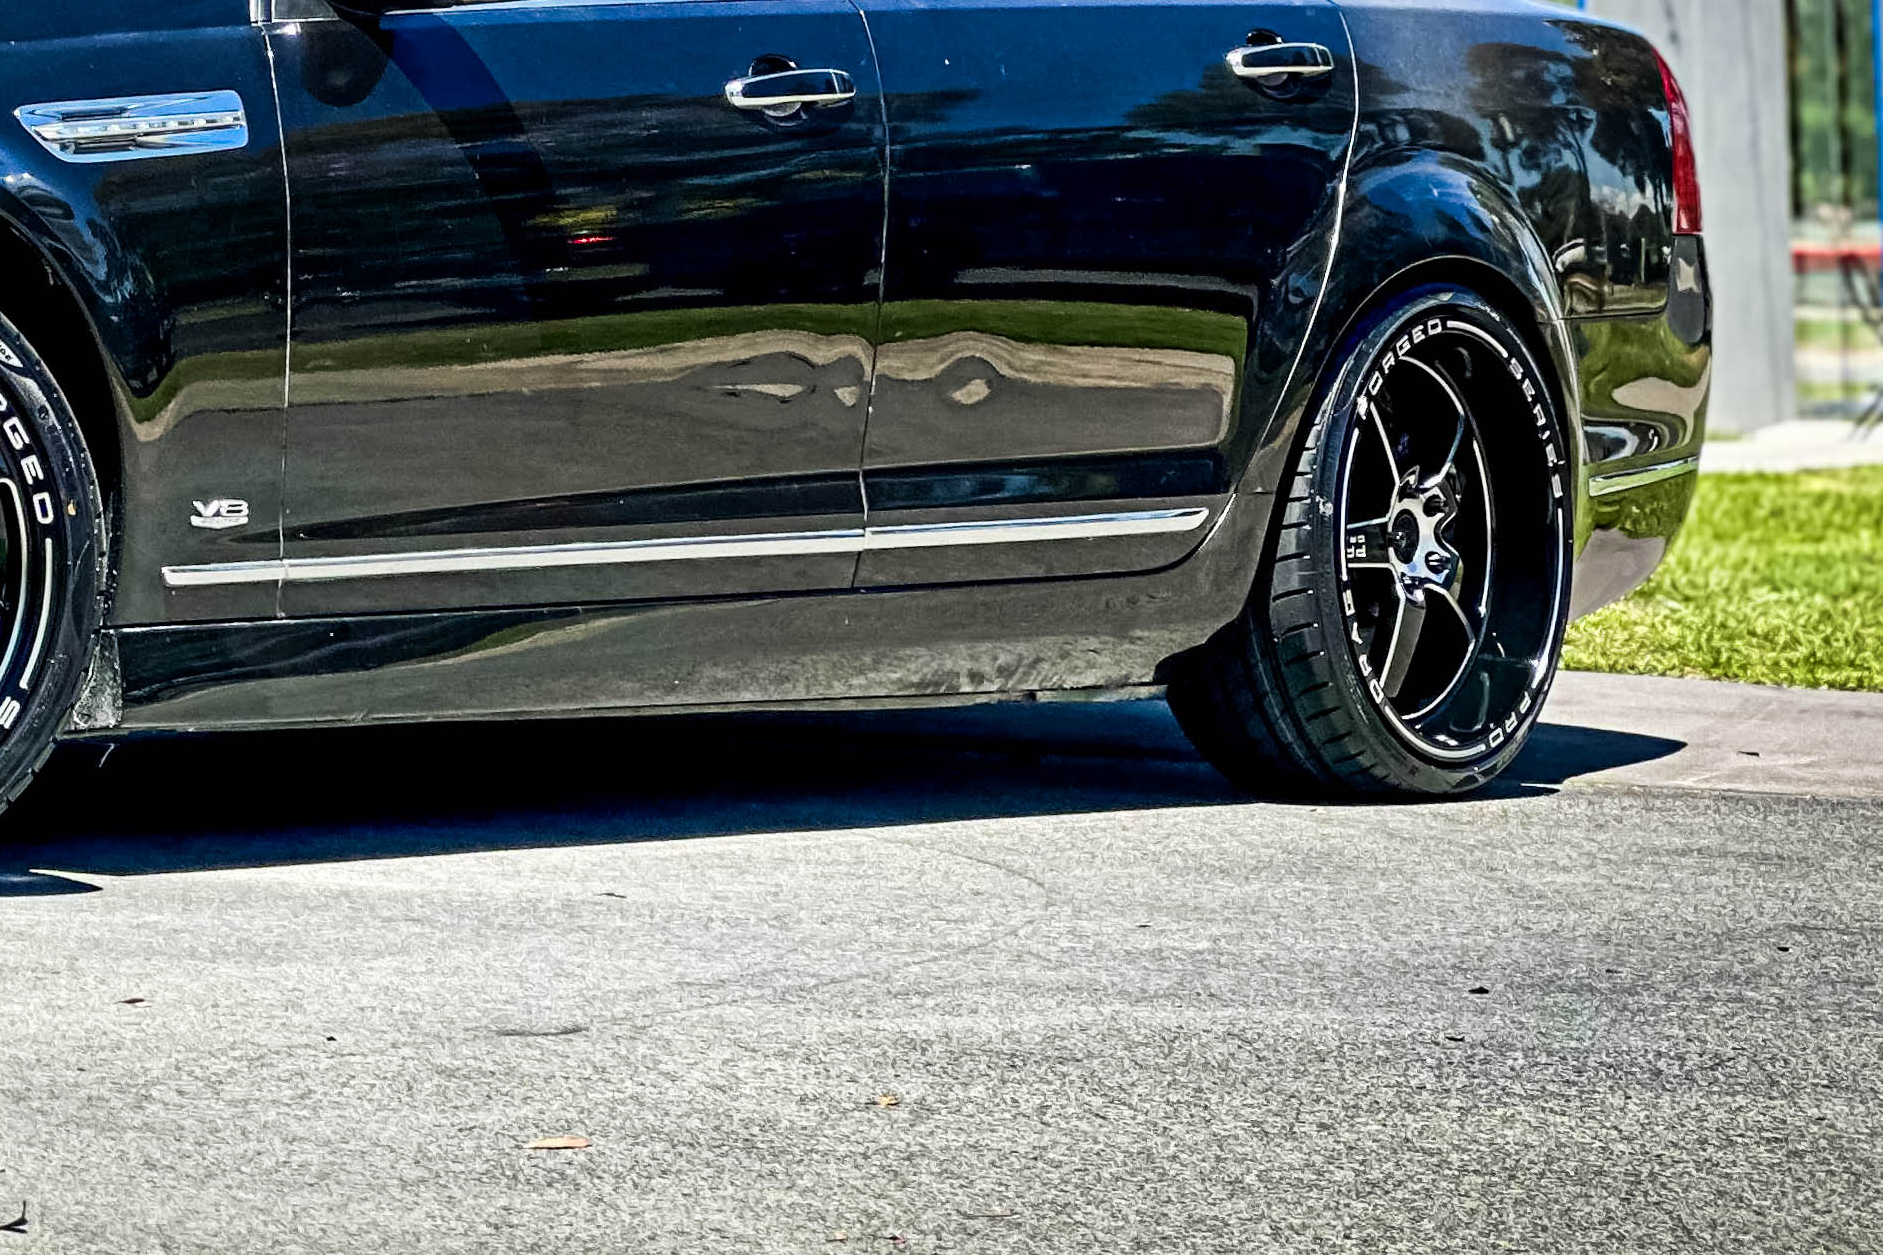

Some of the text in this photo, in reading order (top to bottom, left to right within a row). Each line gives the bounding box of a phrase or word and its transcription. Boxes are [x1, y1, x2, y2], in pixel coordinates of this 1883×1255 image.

[1509, 357, 1564, 499] SERIES
[1343, 589, 1384, 704] DRAG
[1489, 691, 1532, 748] PRO
